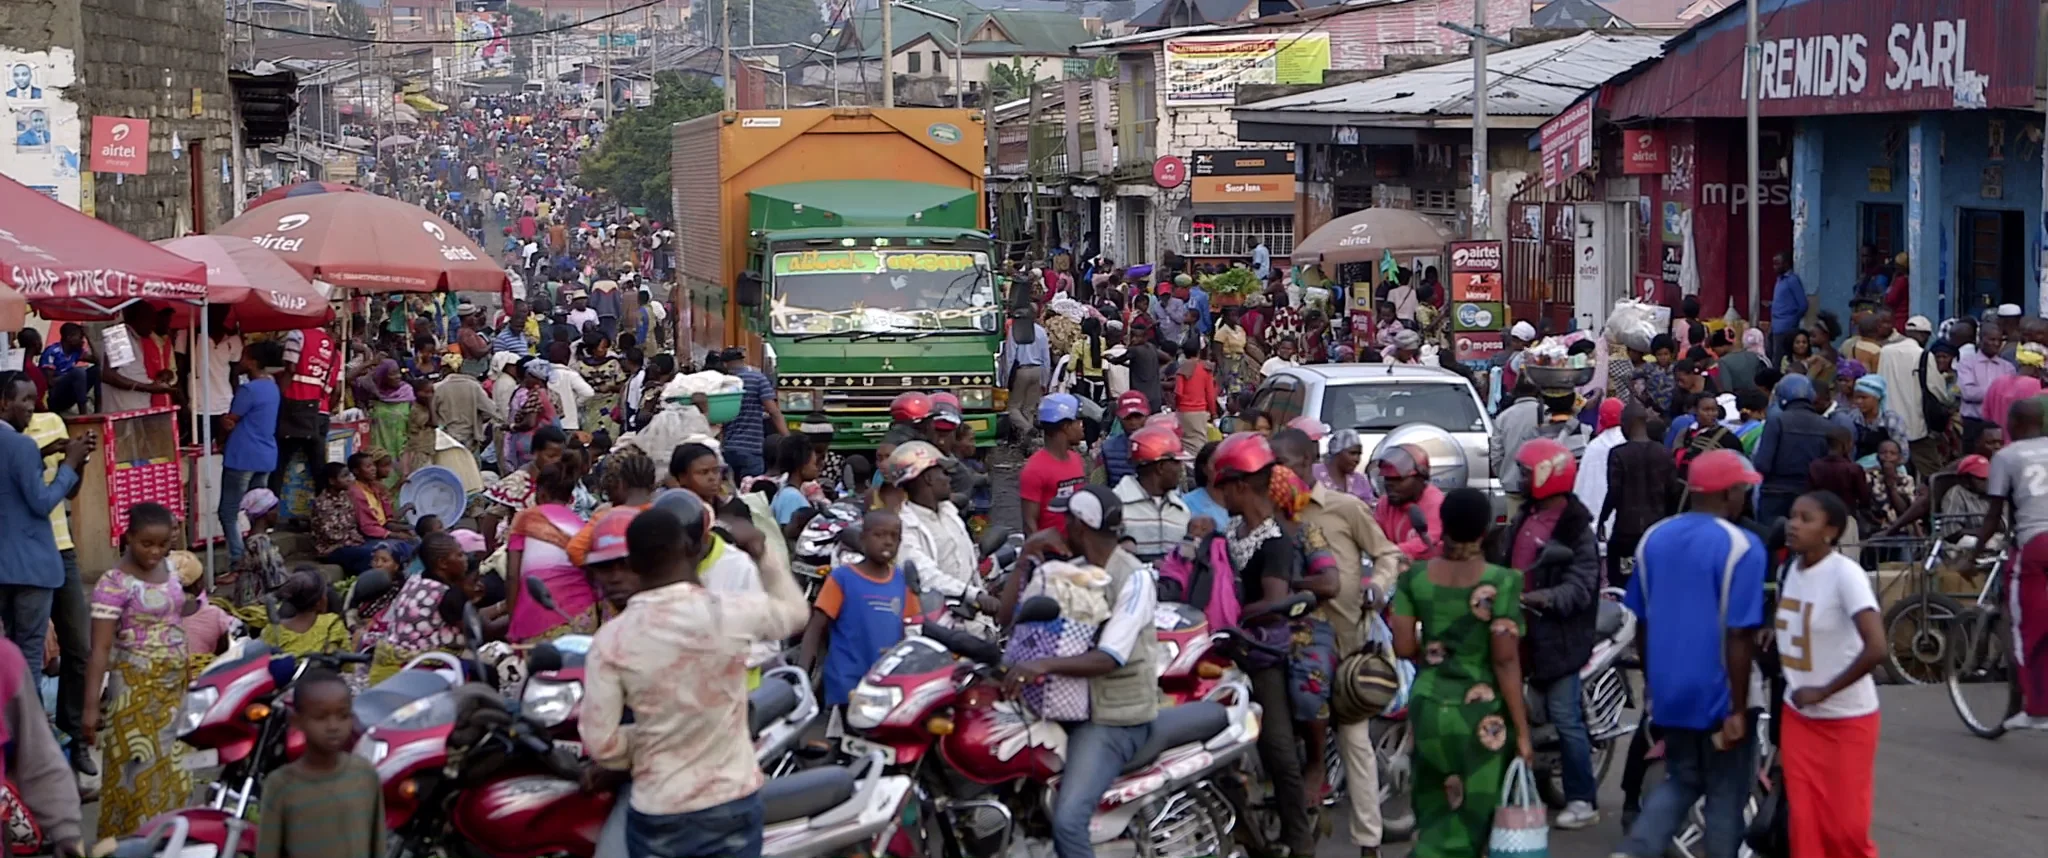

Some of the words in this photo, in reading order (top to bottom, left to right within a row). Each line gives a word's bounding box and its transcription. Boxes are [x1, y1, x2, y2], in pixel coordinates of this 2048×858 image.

[1885, 18, 1966, 91] SARL
[102, 143, 136, 158] airtel
[1632, 150, 1658, 162] airtel
[252, 233, 304, 252] airtel
[1339, 235, 1371, 246] airtel
[1468, 246, 1500, 258] airtel
[1466, 258, 1499, 269] money
[1579, 263, 1599, 275] airtel
[12, 265, 60, 297] SWAP
[64, 268, 139, 297] DIRECTE
[1465, 291, 1492, 301] Money
[824, 376, 951, 387] FUSO
